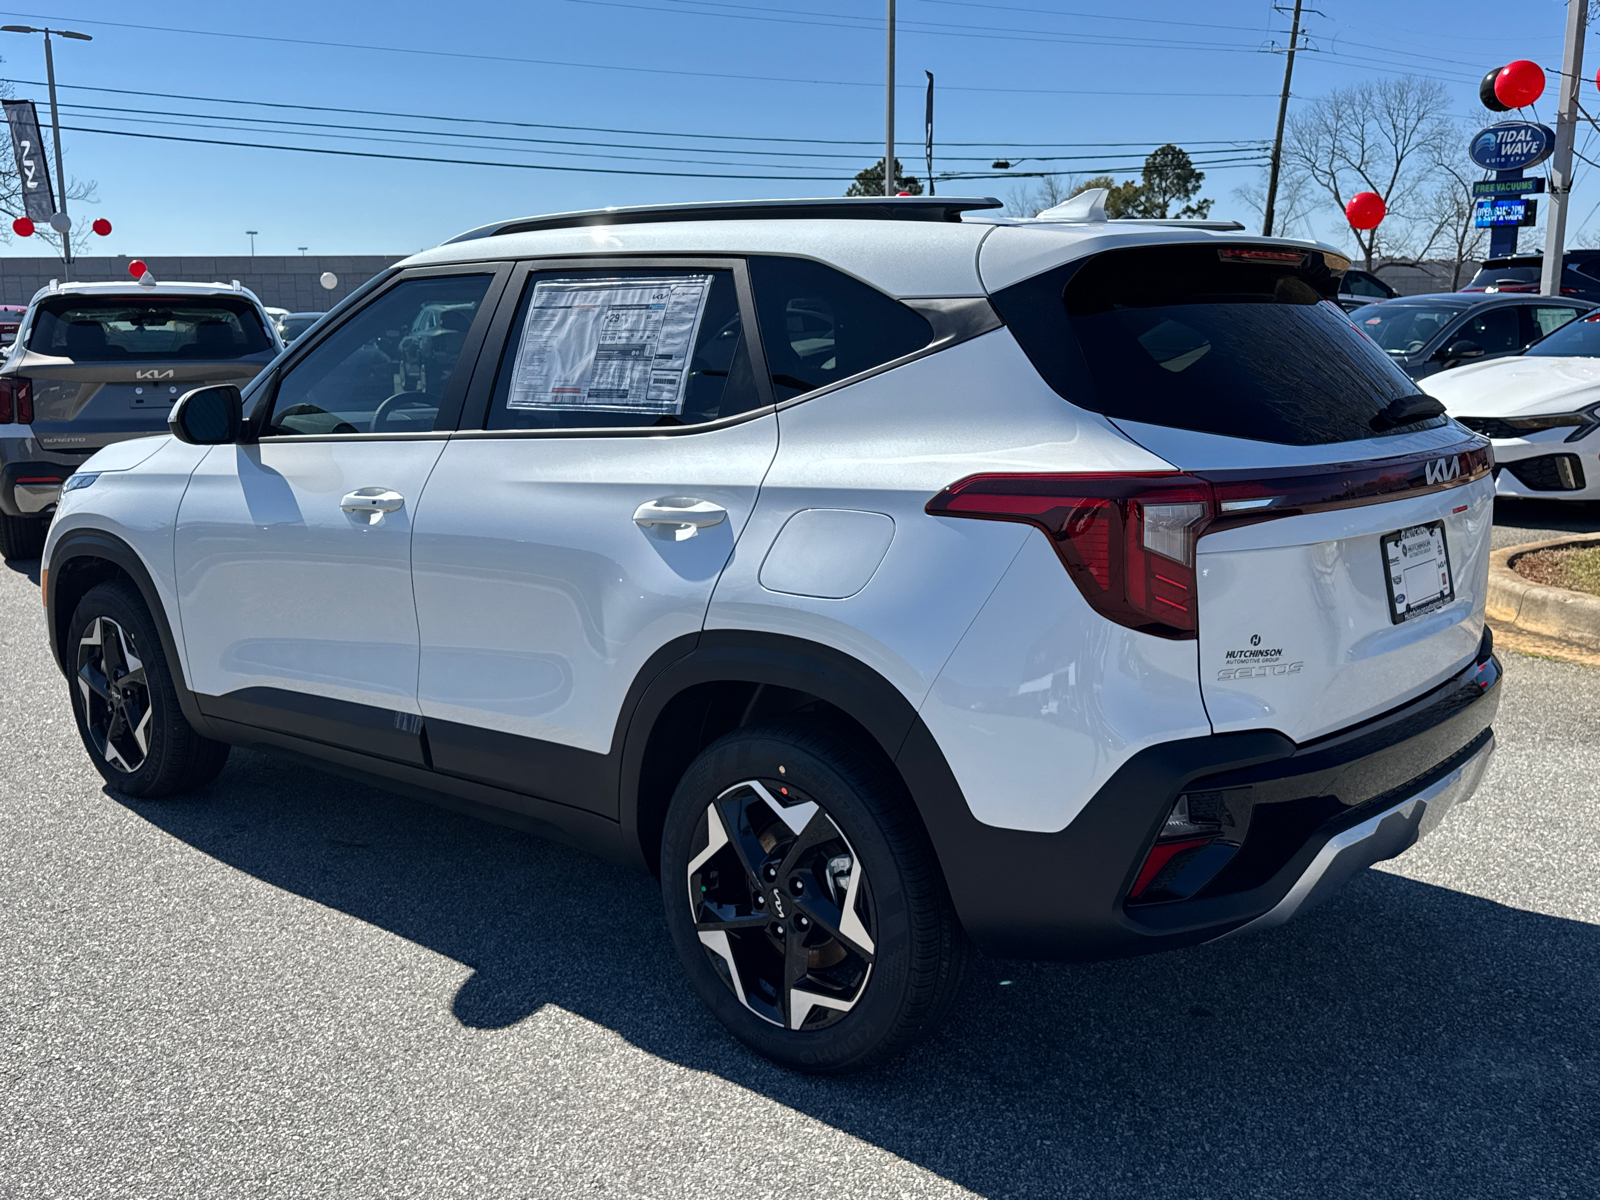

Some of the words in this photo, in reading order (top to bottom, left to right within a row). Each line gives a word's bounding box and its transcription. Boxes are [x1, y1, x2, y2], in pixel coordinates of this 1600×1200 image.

[1496, 129, 1533, 143] TIDAL
[1500, 141, 1540, 156] WAVE
[1475, 183, 1495, 193] FREE
[1496, 181, 1533, 192] VACUUMS
[609, 313, 620, 323] 29
[135, 369, 174, 379] KIA
[1425, 455, 1461, 485] KIA
[1225, 648, 1283, 659] HUTCHINSON
[1225, 657, 1261, 665] AUTOMOTIVE
[1217, 661, 1304, 681] SELTOS
